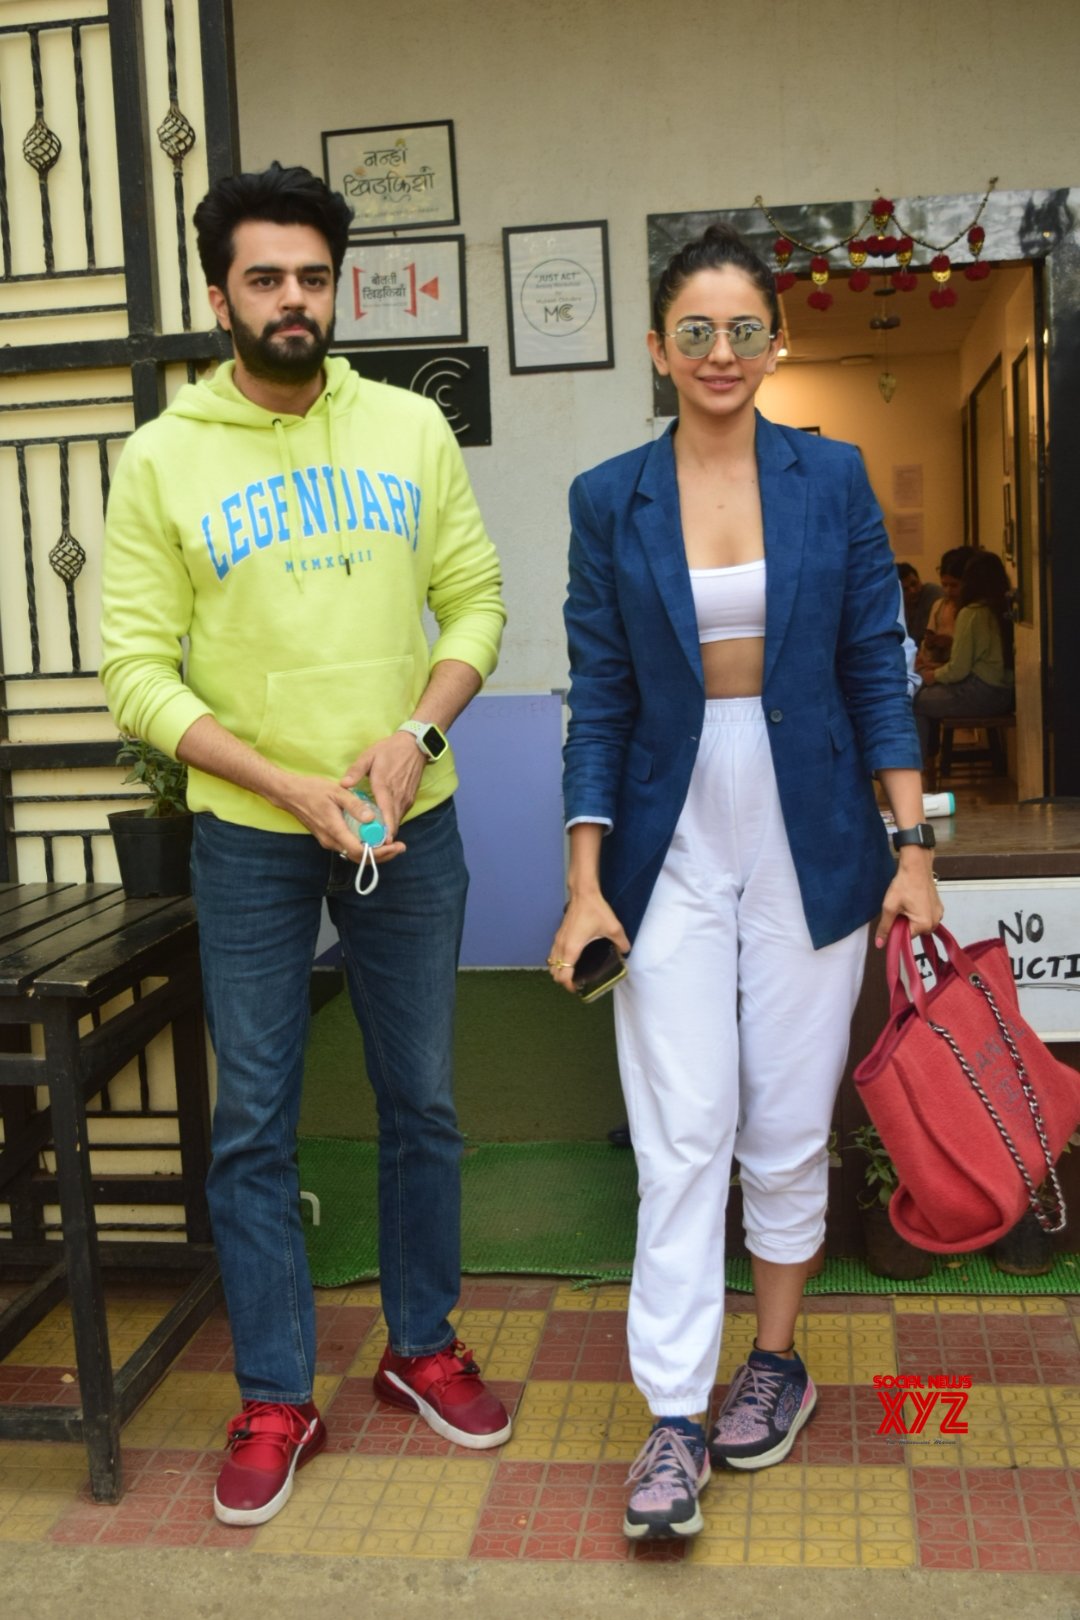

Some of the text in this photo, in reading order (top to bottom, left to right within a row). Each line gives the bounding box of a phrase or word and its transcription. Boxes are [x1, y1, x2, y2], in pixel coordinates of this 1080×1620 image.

[201, 464, 422, 580] LEGENDARY
[998, 910, 1044, 944] NO
[1008, 954, 1080, 980] UCTI
